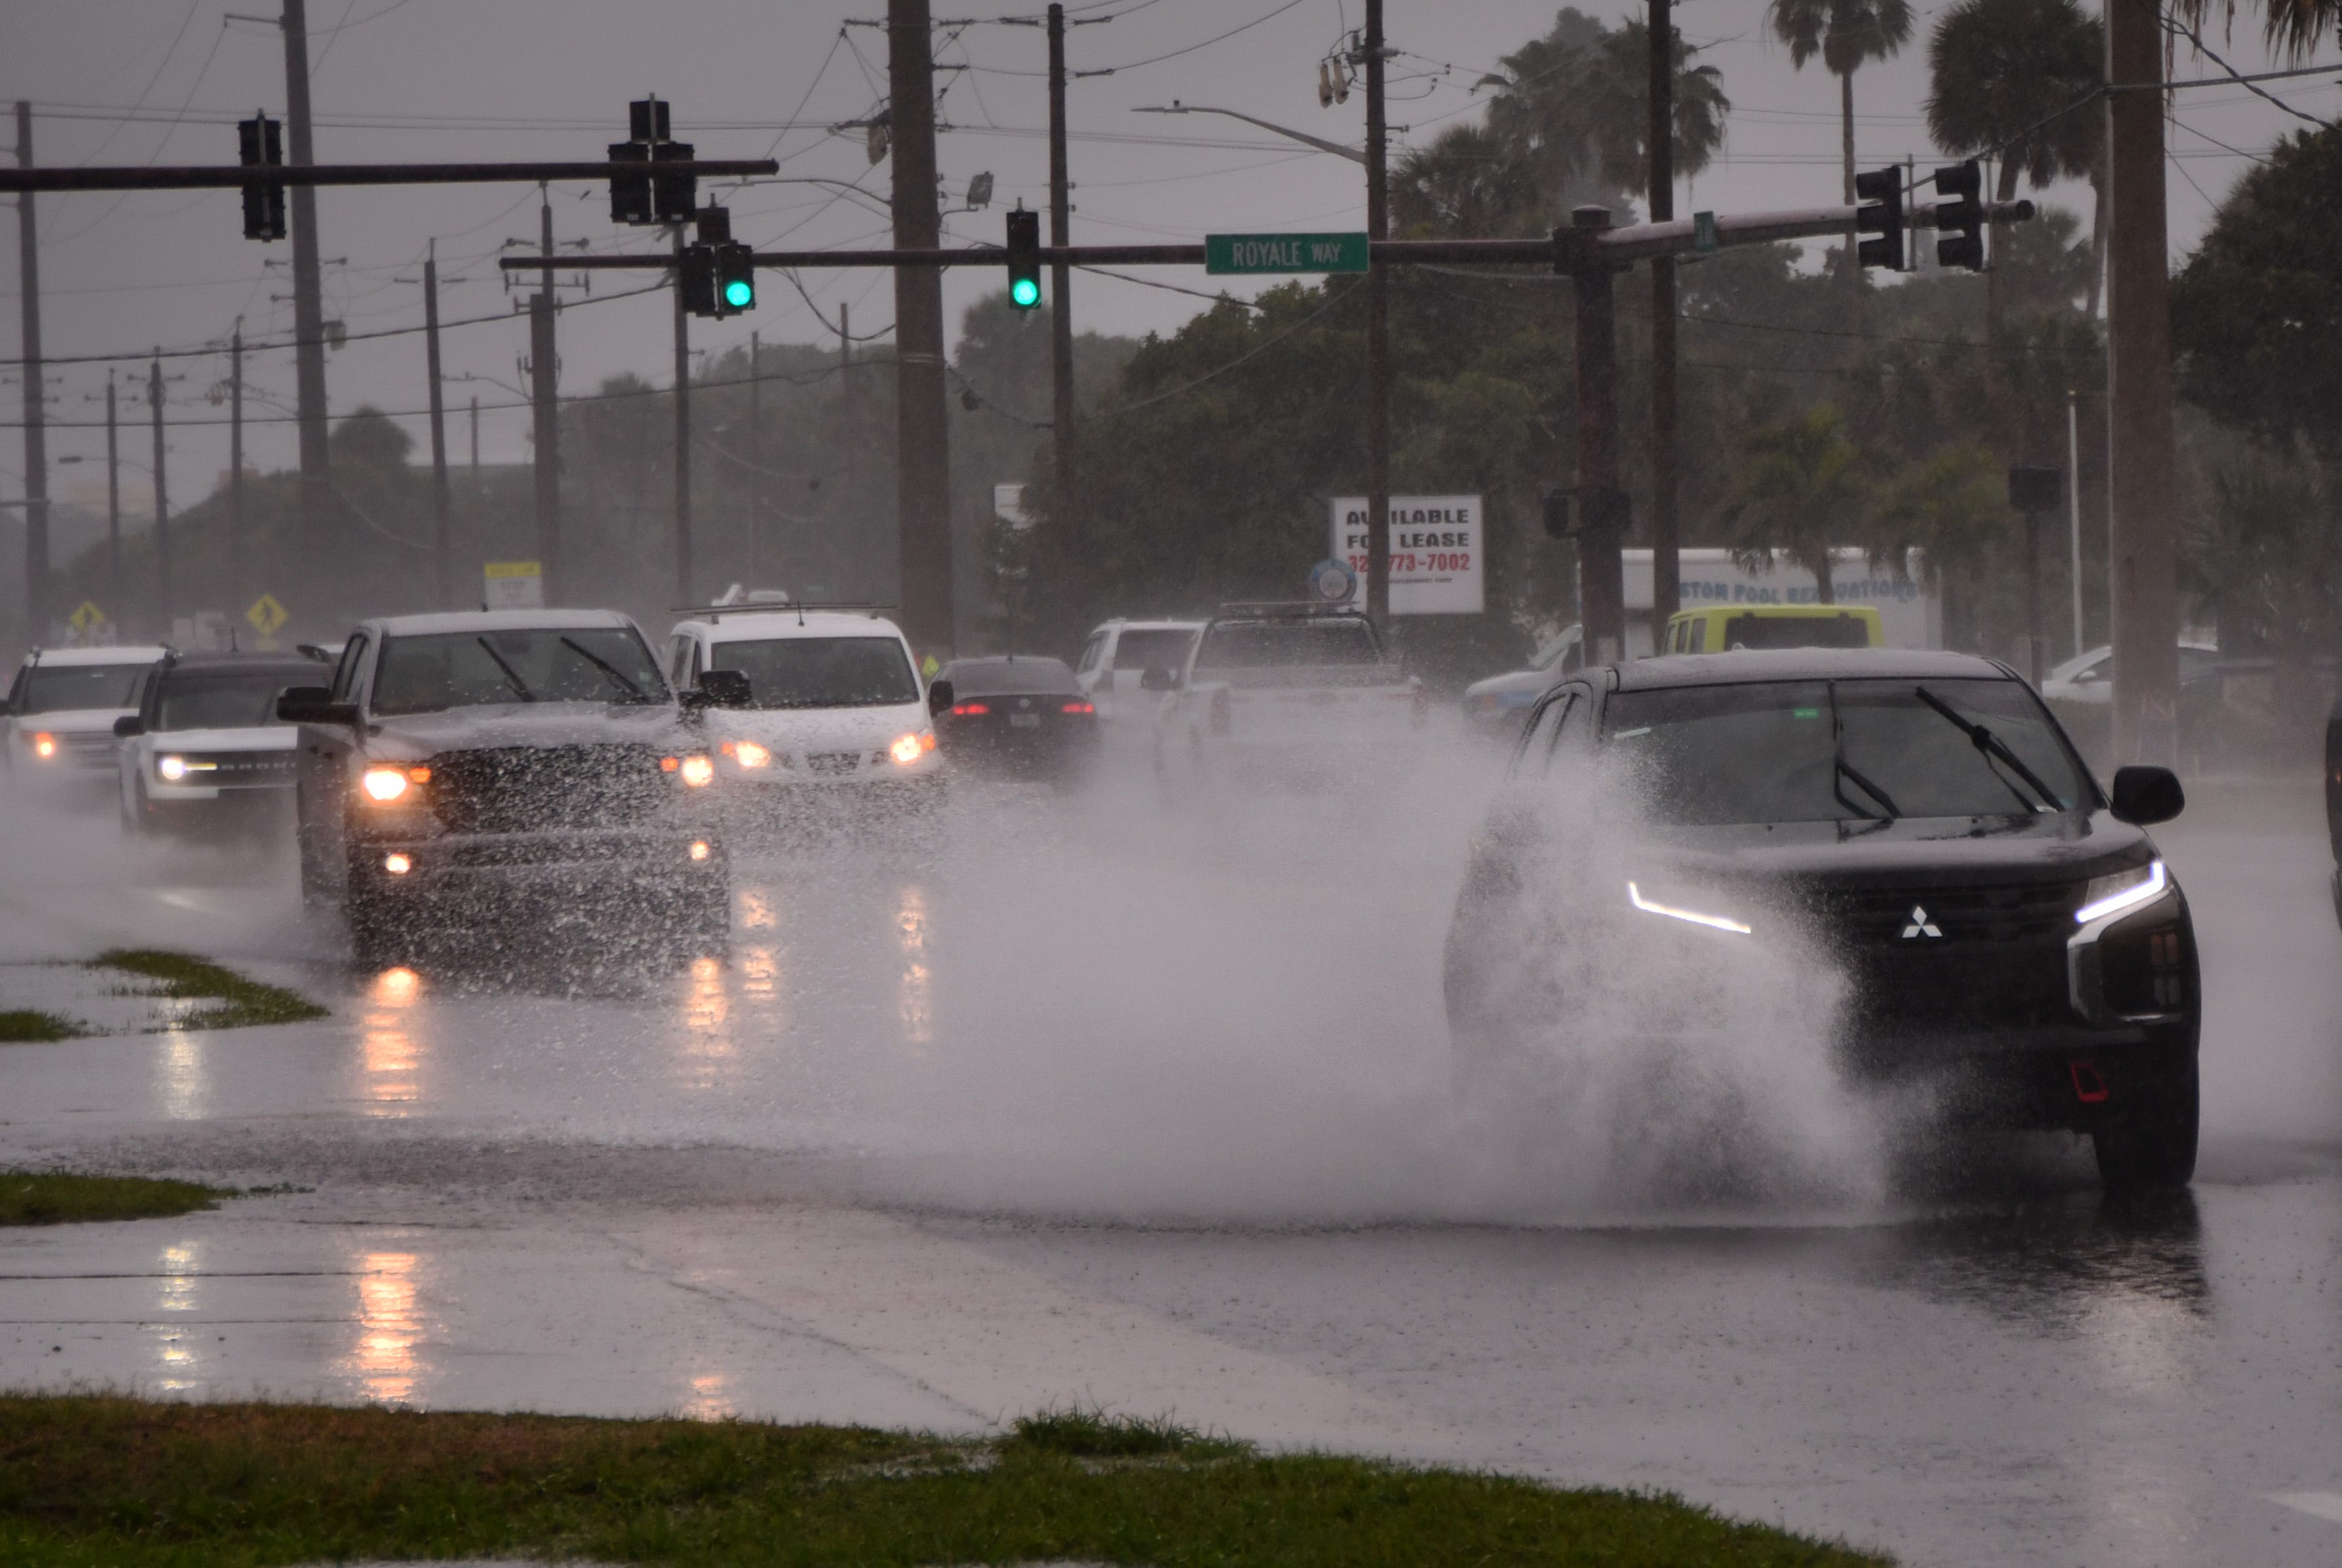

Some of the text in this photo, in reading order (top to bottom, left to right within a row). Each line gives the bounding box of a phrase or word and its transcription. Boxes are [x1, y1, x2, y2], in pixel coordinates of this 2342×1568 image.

[1233, 241, 1341, 267] ROYALE WAY
[1346, 509, 1470, 526] AVILABLE
[1347, 533, 1470, 549] FO LEASE
